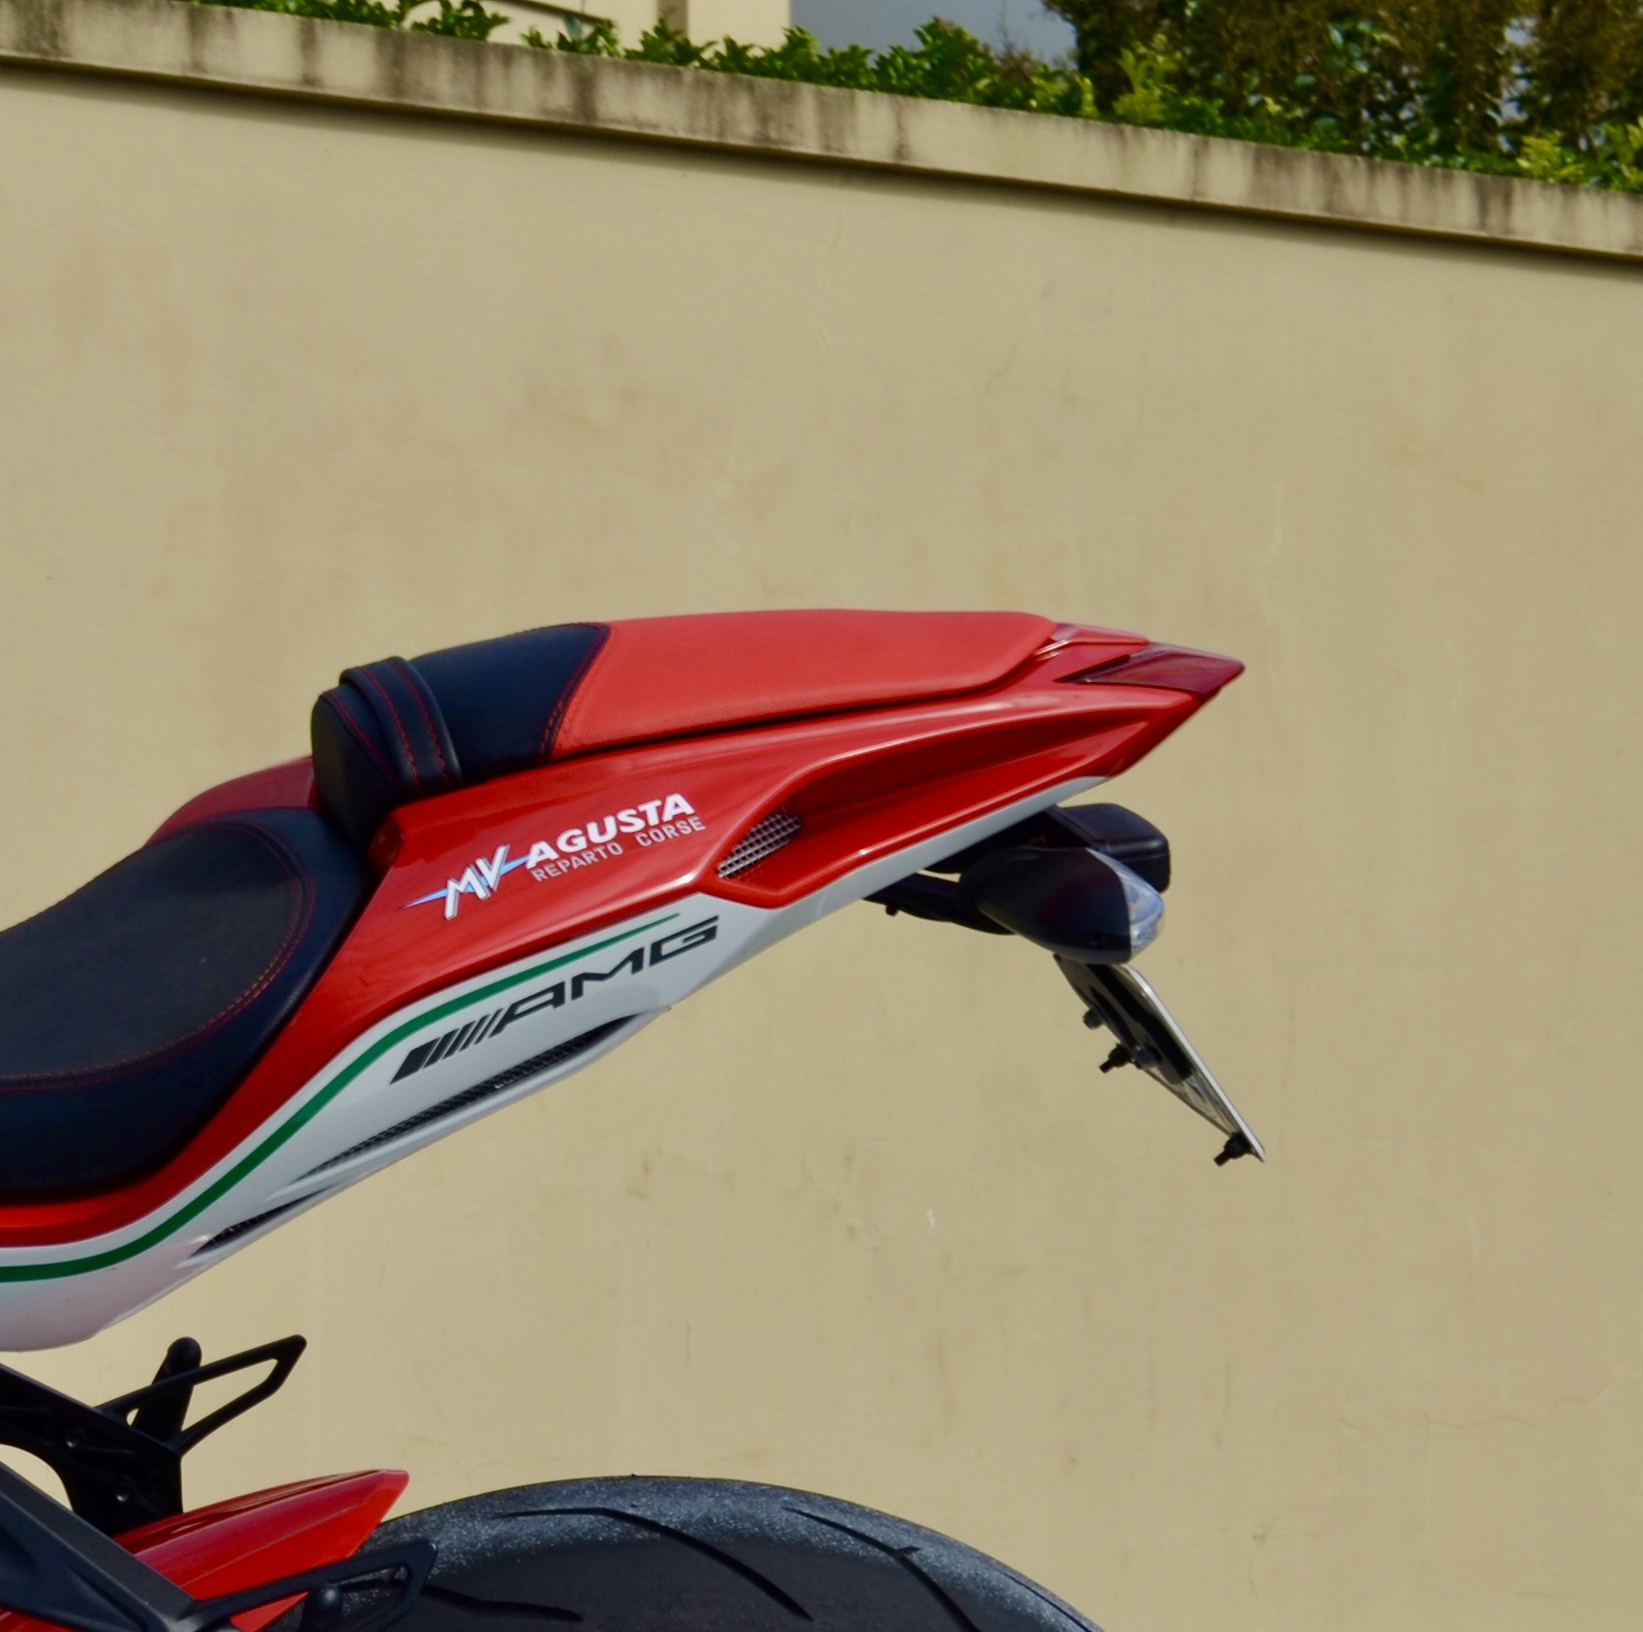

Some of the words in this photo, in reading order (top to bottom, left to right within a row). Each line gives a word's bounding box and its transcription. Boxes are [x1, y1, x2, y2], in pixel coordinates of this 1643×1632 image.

[444, 843, 511, 921] MV
[525, 792, 696, 870] AGUSTA
[531, 841, 624, 882] REPARTO
[636, 815, 707, 848] CORSE
